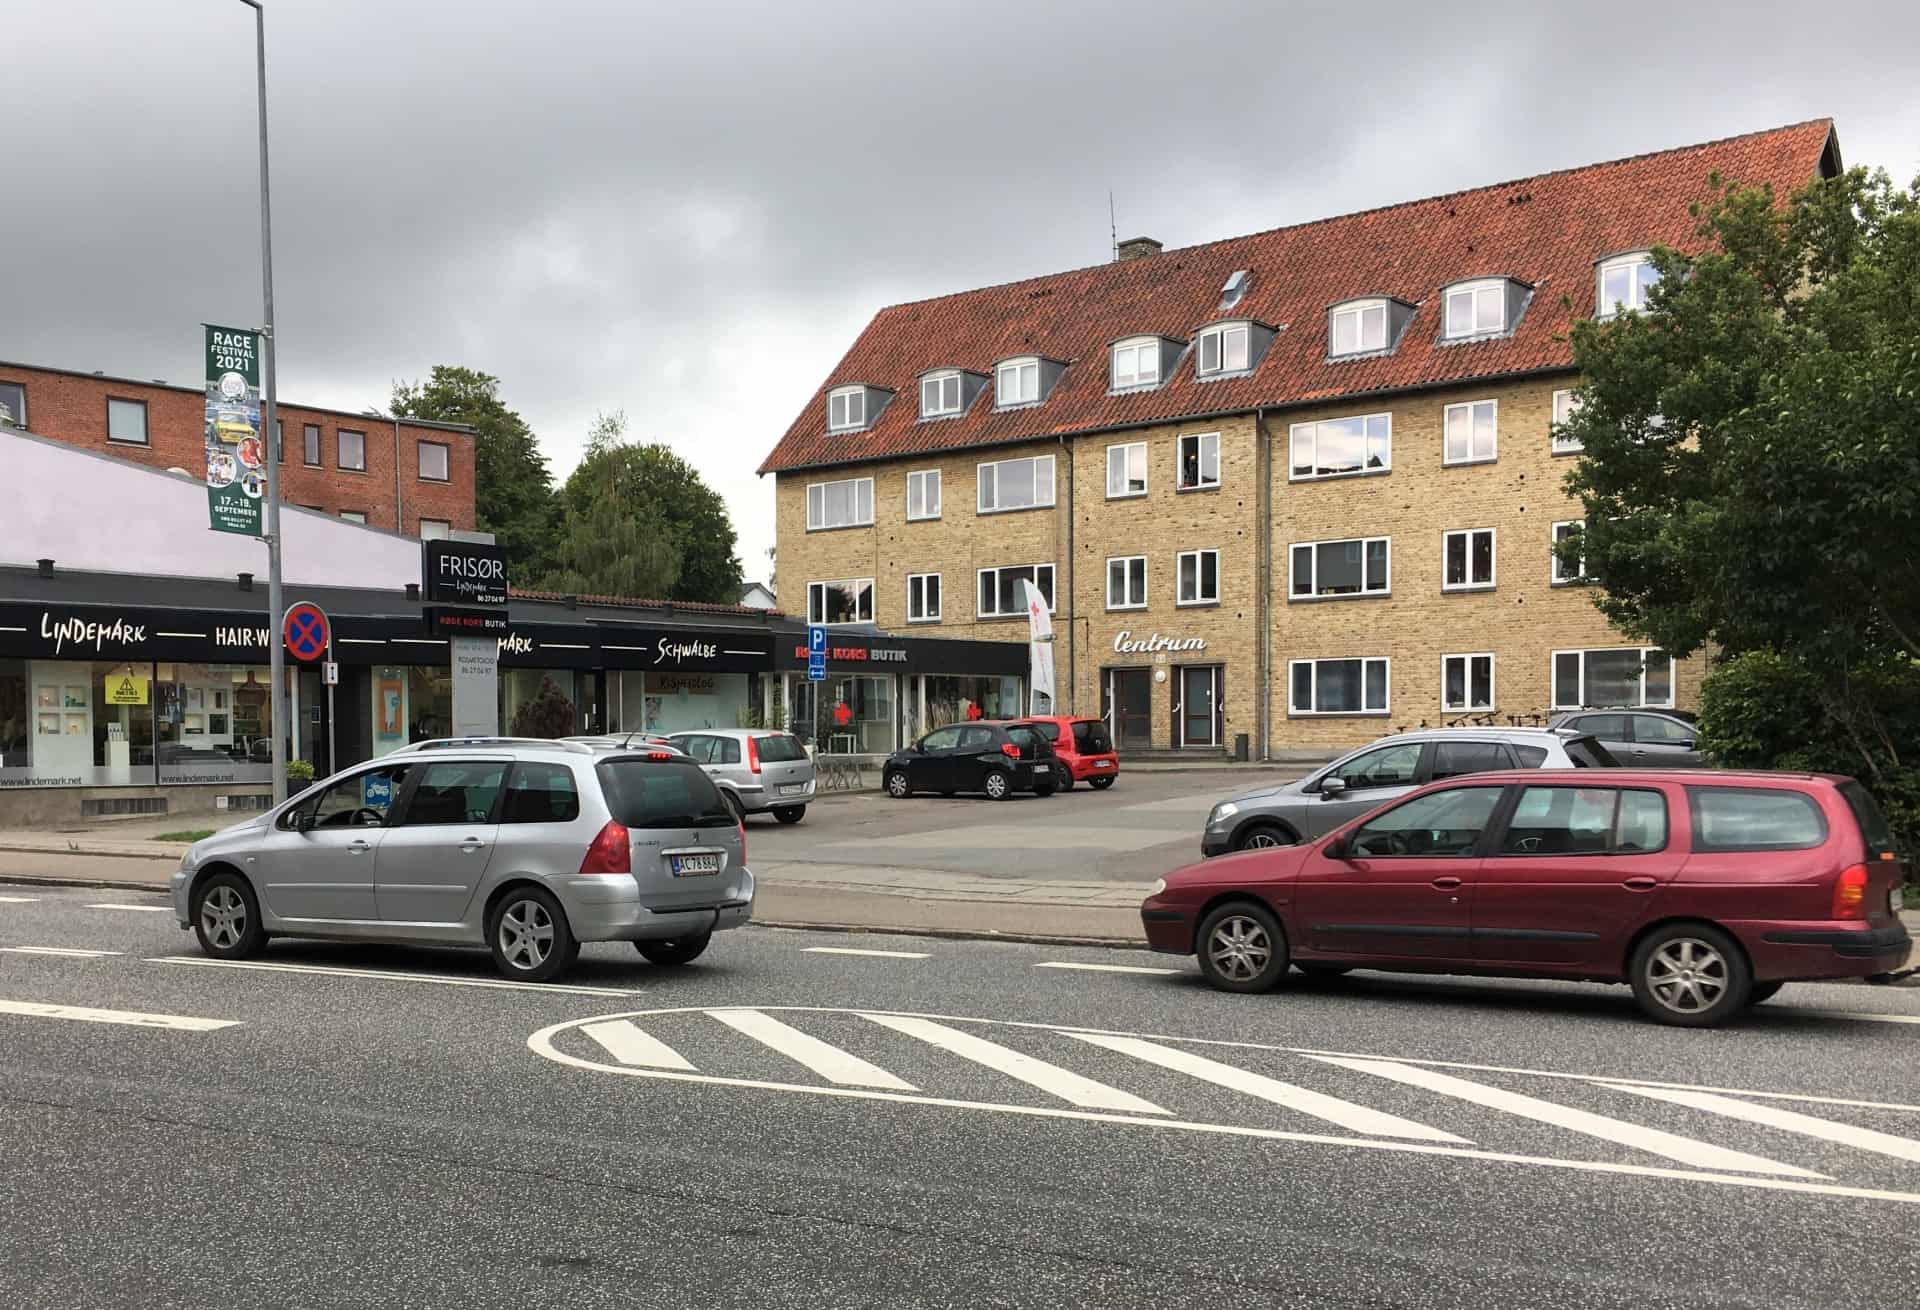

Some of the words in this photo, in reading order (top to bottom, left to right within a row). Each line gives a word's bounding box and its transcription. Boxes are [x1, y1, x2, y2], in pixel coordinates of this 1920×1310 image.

[214, 331, 252, 349] RACE
[210, 344, 255, 359] FESTIVAL
[216, 355, 249, 371] 2021
[441, 555, 505, 579] FRISØR
[484, 619, 507, 628] BUTIK
[41, 612, 147, 655] LINDEMARK
[813, 629, 823, 650] P
[1113, 630, 1208, 653] Centrum
[653, 637, 717, 664] SCHWALBE
[870, 649, 908, 662] BUTIK
[0, 775, 82, 785] www.lindemark.net
